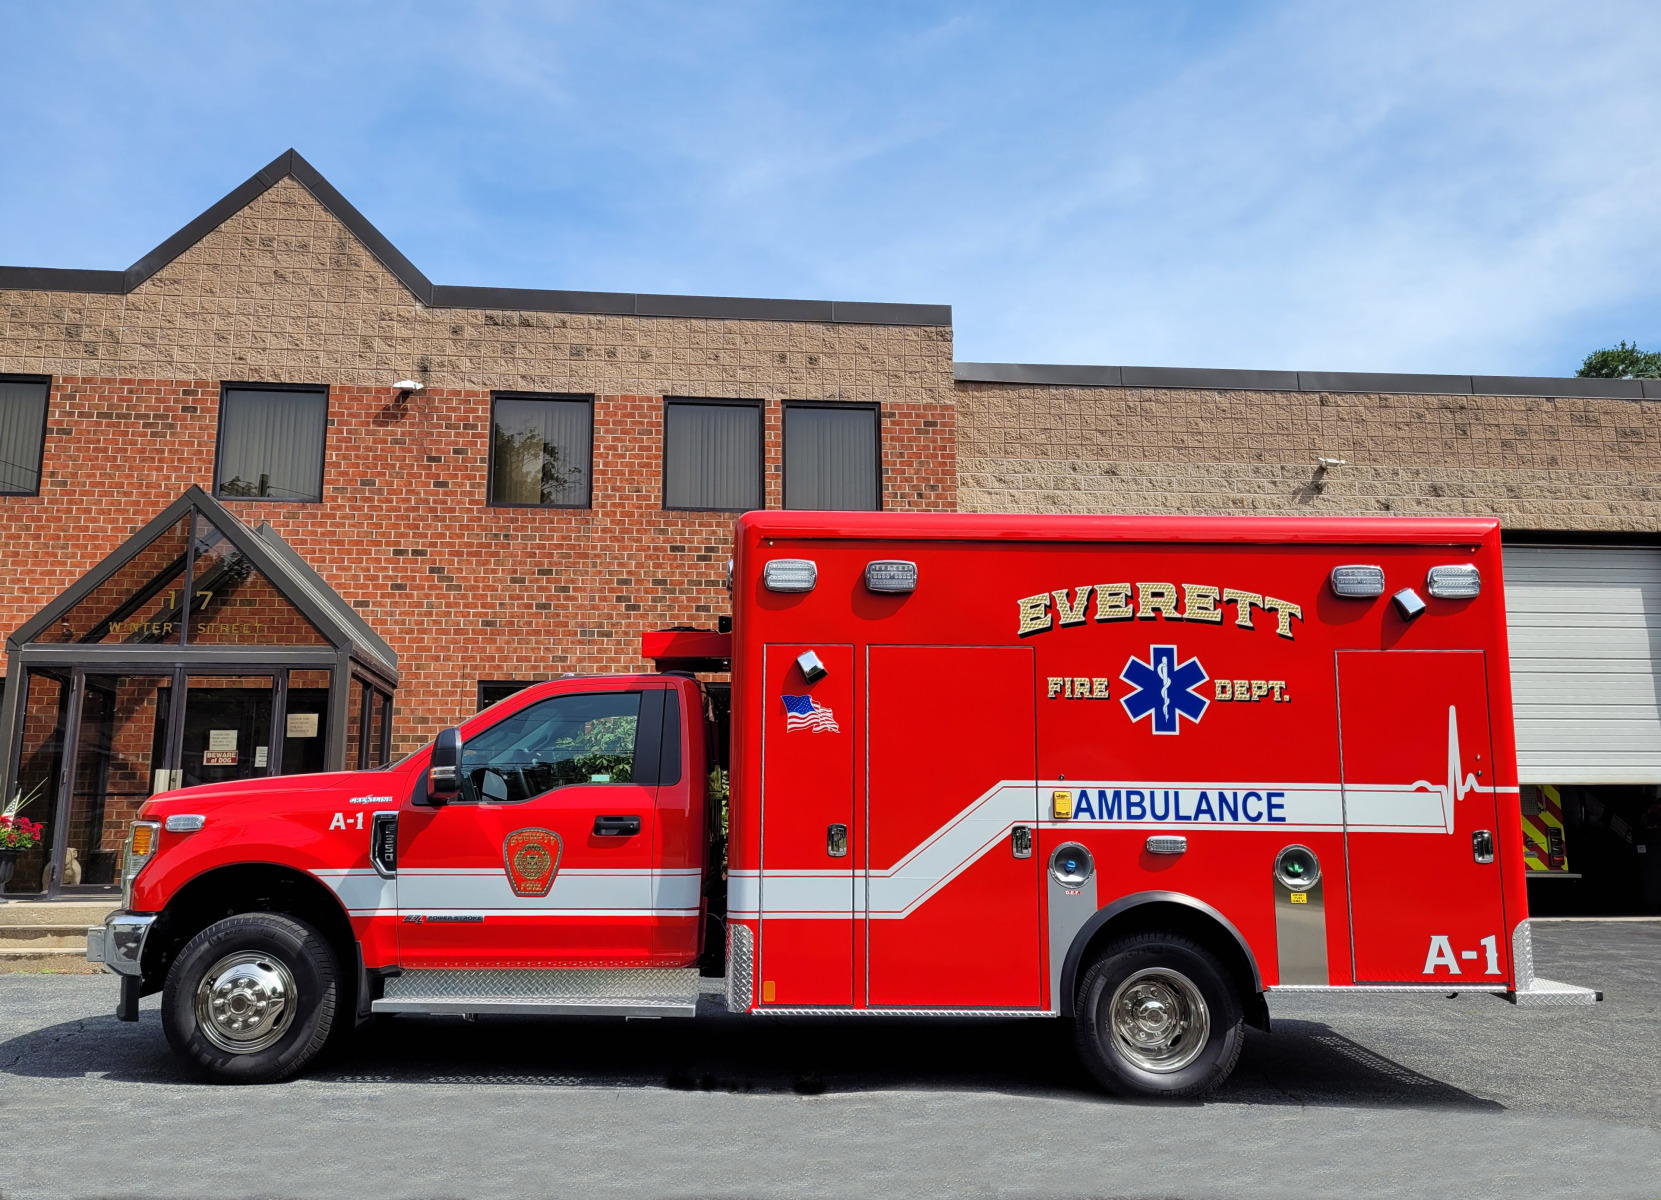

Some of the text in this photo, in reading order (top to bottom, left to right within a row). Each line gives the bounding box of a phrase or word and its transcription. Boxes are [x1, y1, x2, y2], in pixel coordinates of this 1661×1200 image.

[1017, 582, 1303, 638] EVERETT
[109, 621, 263, 634] WINTER STREET
[1047, 677, 1291, 702] FIRE DEPT.
[1072, 789, 1287, 823] AMBULANCE
[328, 811, 364, 831] A-1
[510, 832, 556, 847] EVERETT
[1421, 934, 1502, 975] A-1
